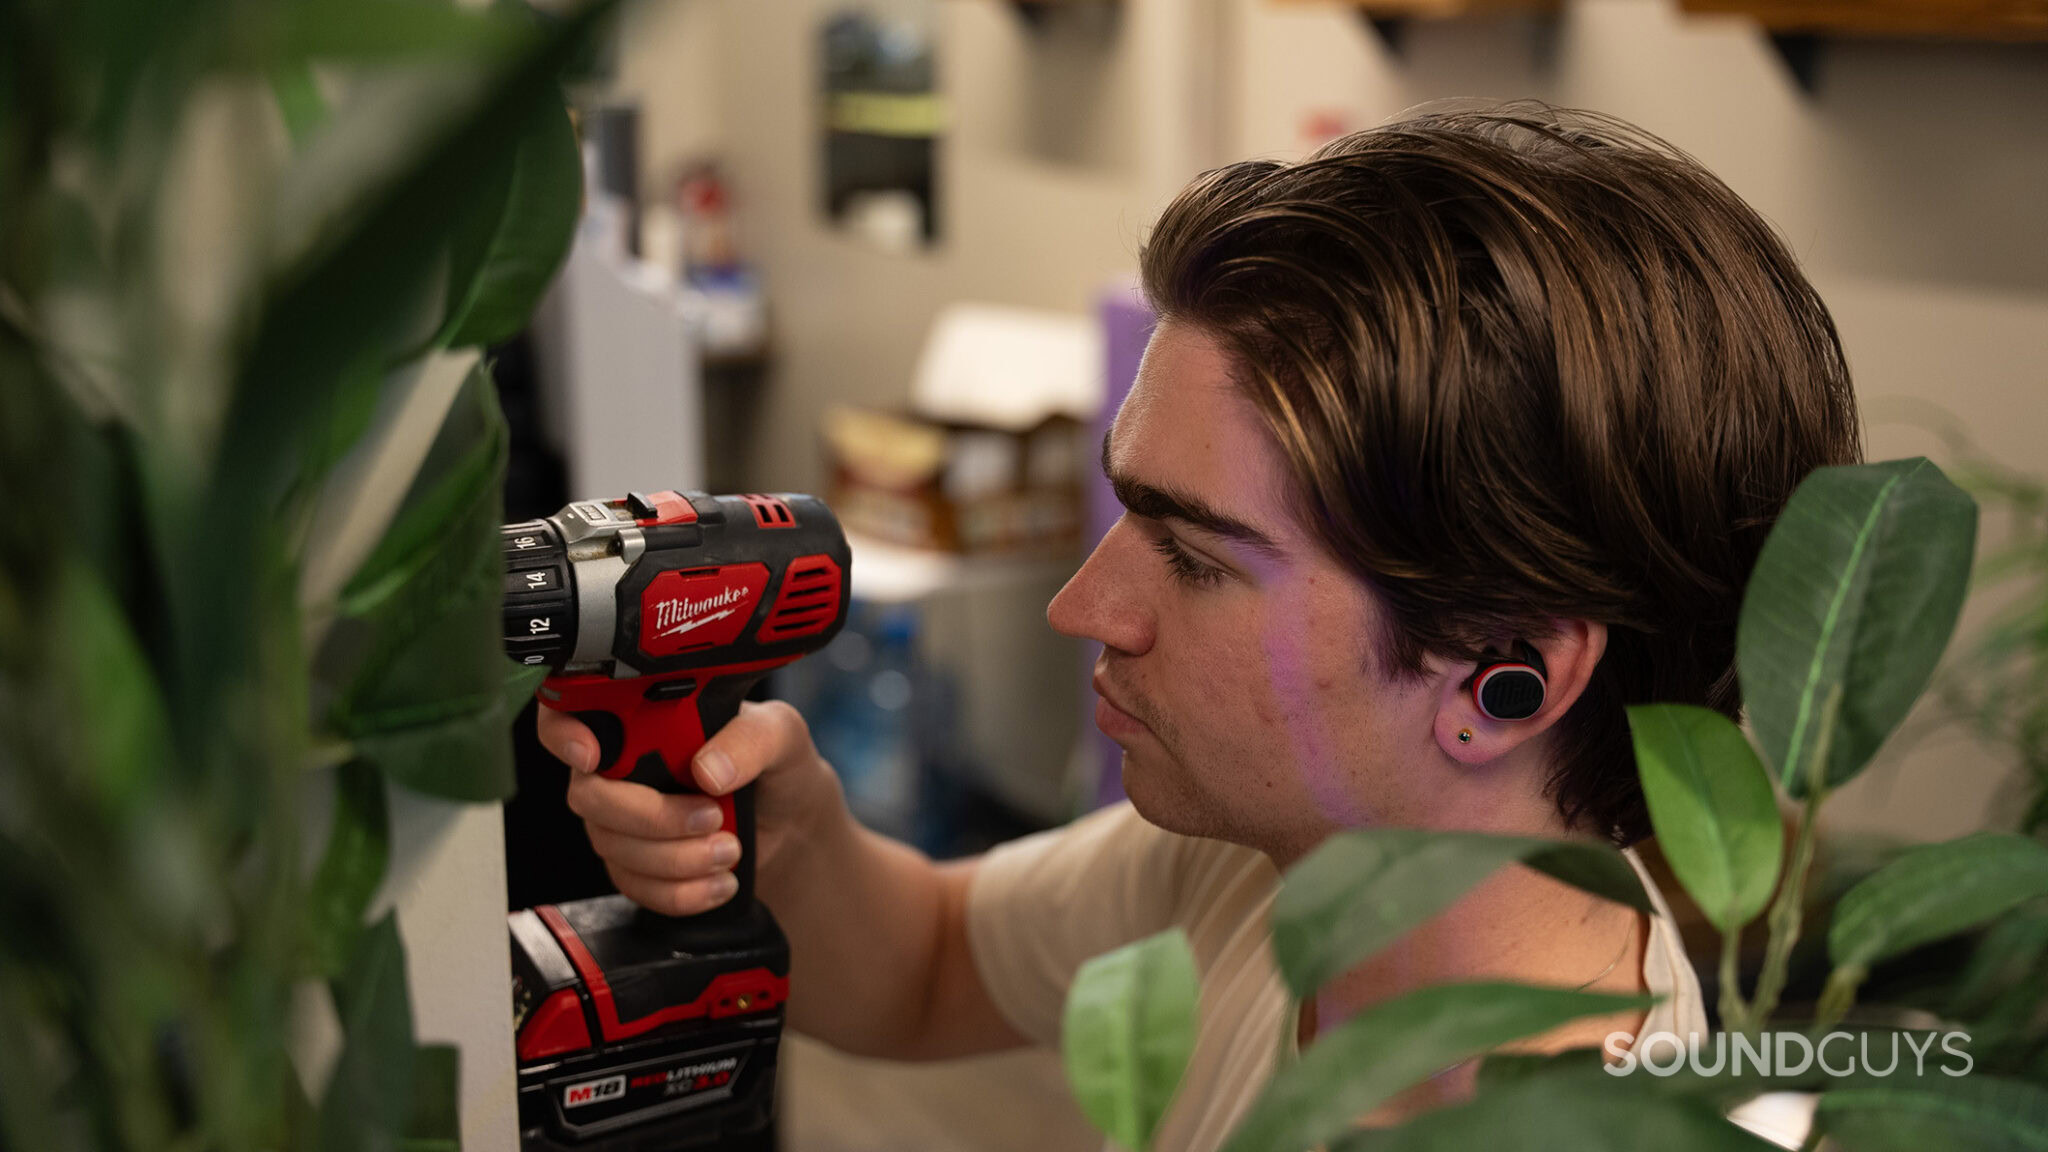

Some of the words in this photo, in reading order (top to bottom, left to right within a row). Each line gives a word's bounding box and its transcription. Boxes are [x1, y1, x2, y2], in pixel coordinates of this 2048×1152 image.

[514, 536, 537, 549] 16
[526, 572, 548, 589] 14
[656, 586, 749, 630] Milwaukee
[530, 617, 551, 635] 12
[524, 655, 545, 665] 10
[569, 1081, 621, 1104] M18
